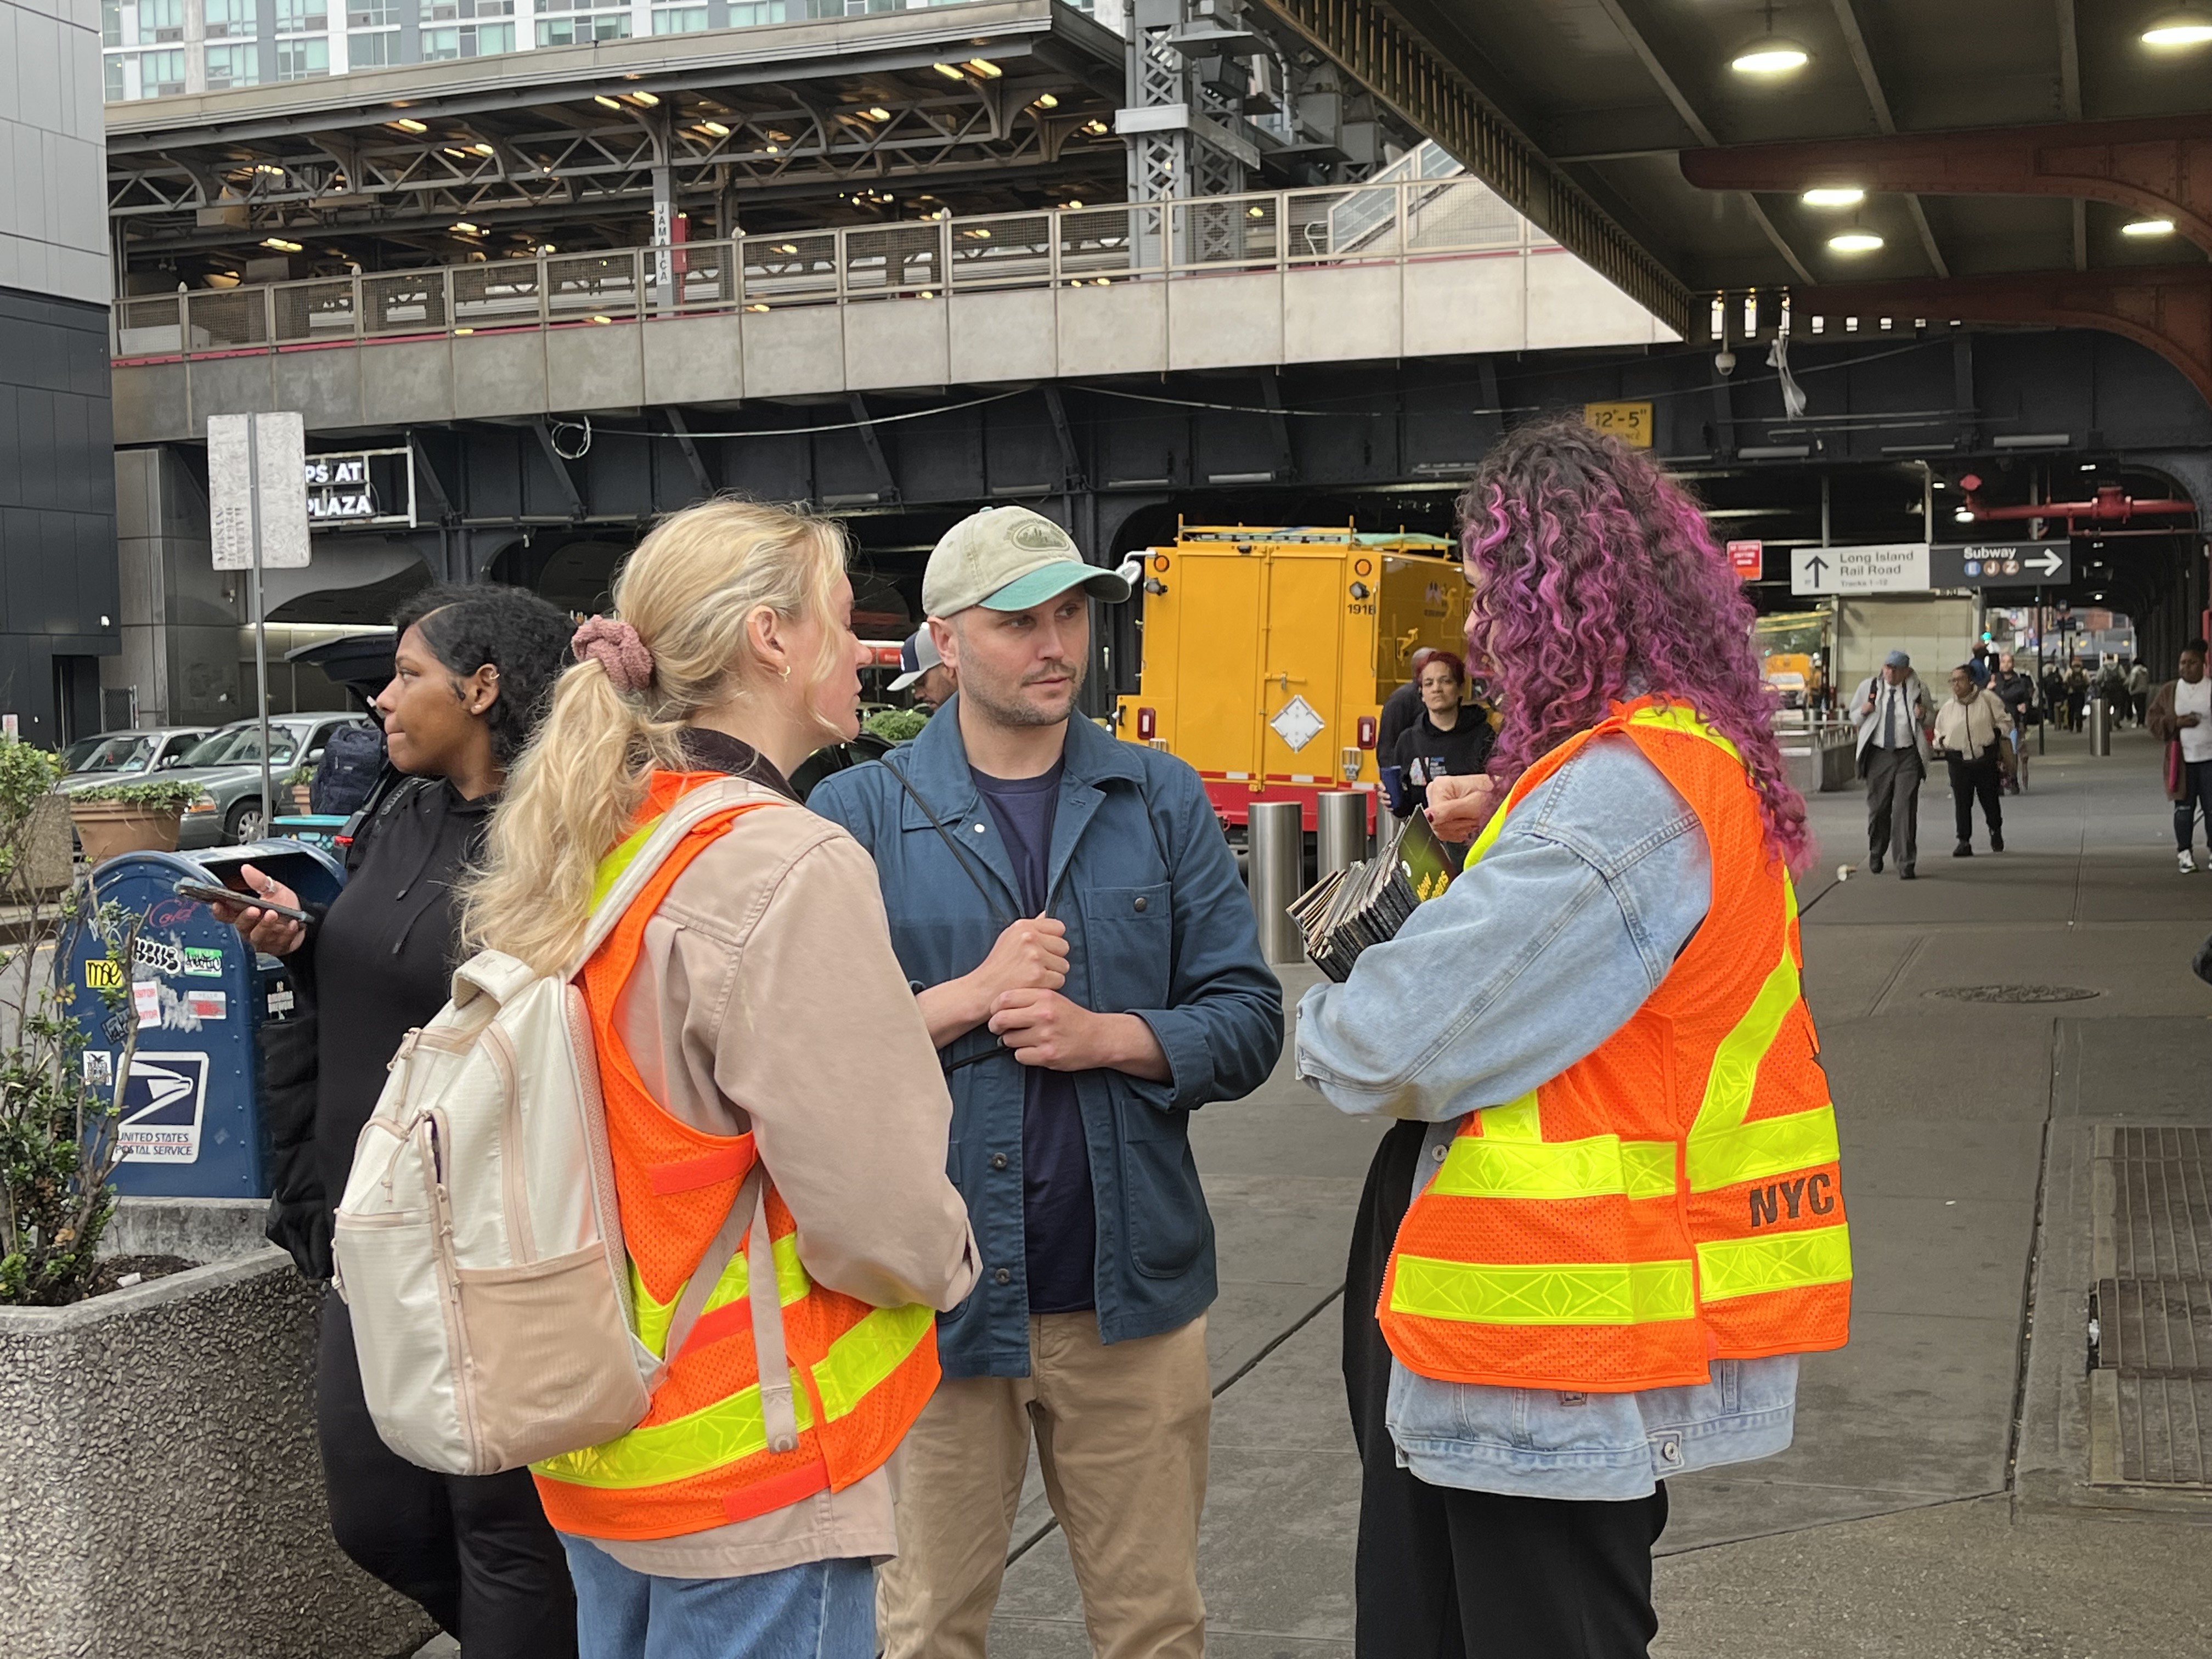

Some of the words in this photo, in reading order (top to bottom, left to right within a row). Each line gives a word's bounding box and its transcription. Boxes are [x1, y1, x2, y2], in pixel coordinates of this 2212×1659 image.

[658, 204, 667, 281] JAMAICA
[335, 462, 362, 482] AT
[1840, 553, 1871, 565] Long
[1876, 550, 1914, 562] Island
[1963, 546, 2016, 560] Subway
[1840, 566, 1864, 576] Rail
[1868, 565, 1901, 576] Road
[155, 1133, 189, 1143] STATES
[115, 1144, 151, 1155] POSTAL
[154, 1146, 194, 1155] SERVICE
[1750, 1172, 1834, 1227] NYC
